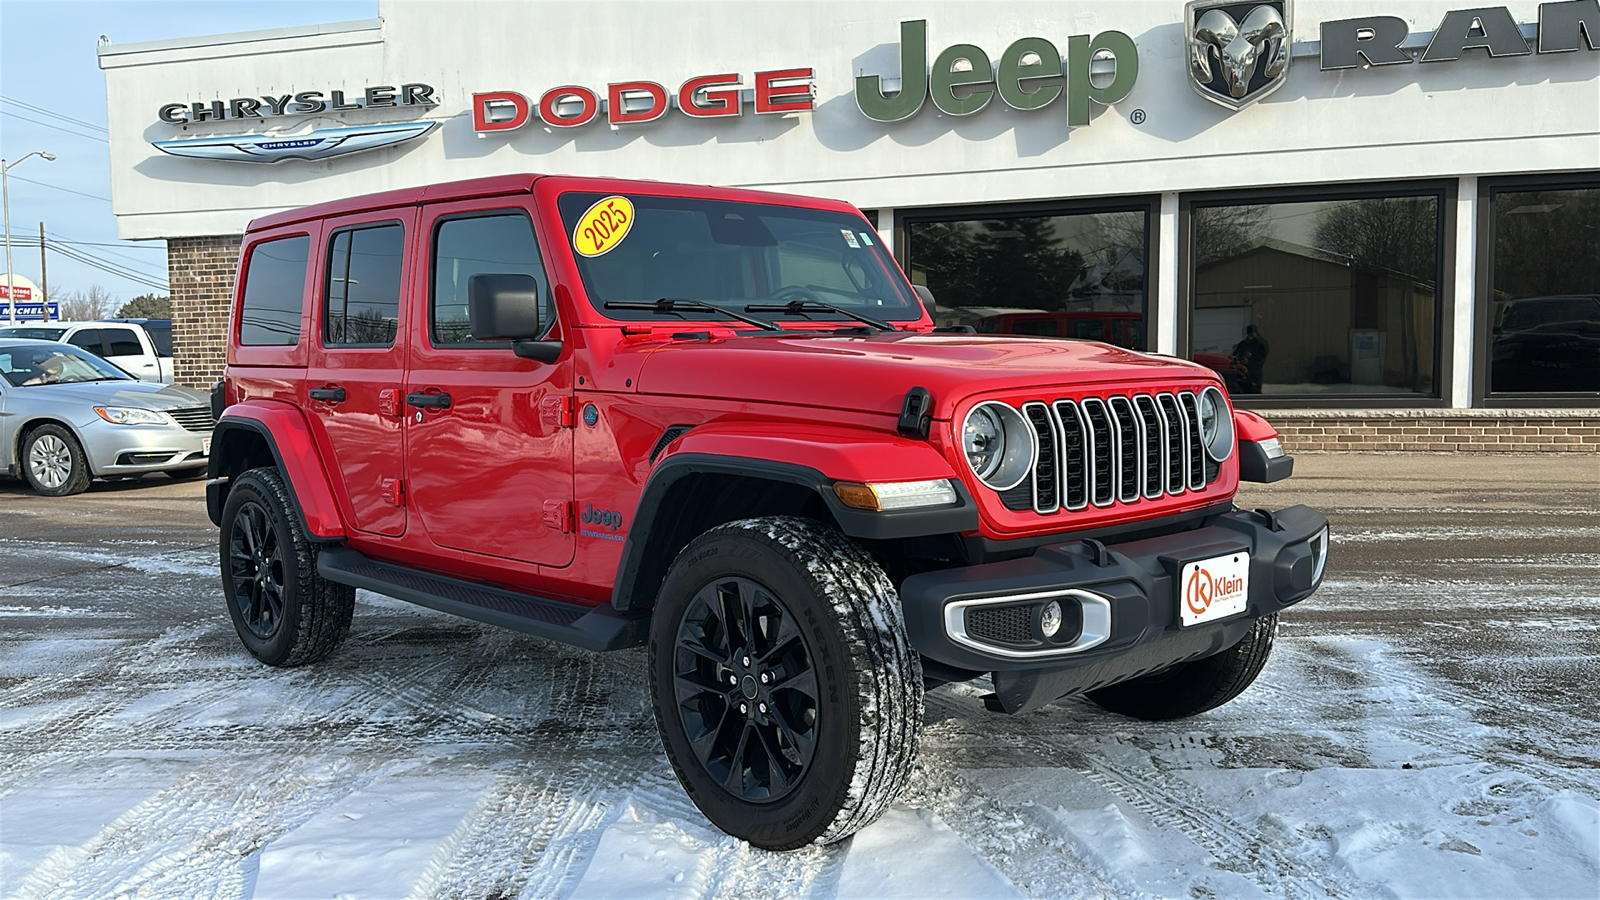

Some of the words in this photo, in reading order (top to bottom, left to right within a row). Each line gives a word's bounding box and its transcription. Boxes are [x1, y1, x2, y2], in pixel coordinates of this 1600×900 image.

[855, 19, 1140, 127] Jeep
[158, 83, 436, 125] CHRYSLER
[472, 67, 816, 133] DODGE
[262, 140, 317, 149] CHRYSLER
[584, 201, 627, 251] 2025
[581, 502, 623, 532] Jeep
[1215, 574, 1243, 597] Klein
[804, 607, 838, 703] NEXEN
